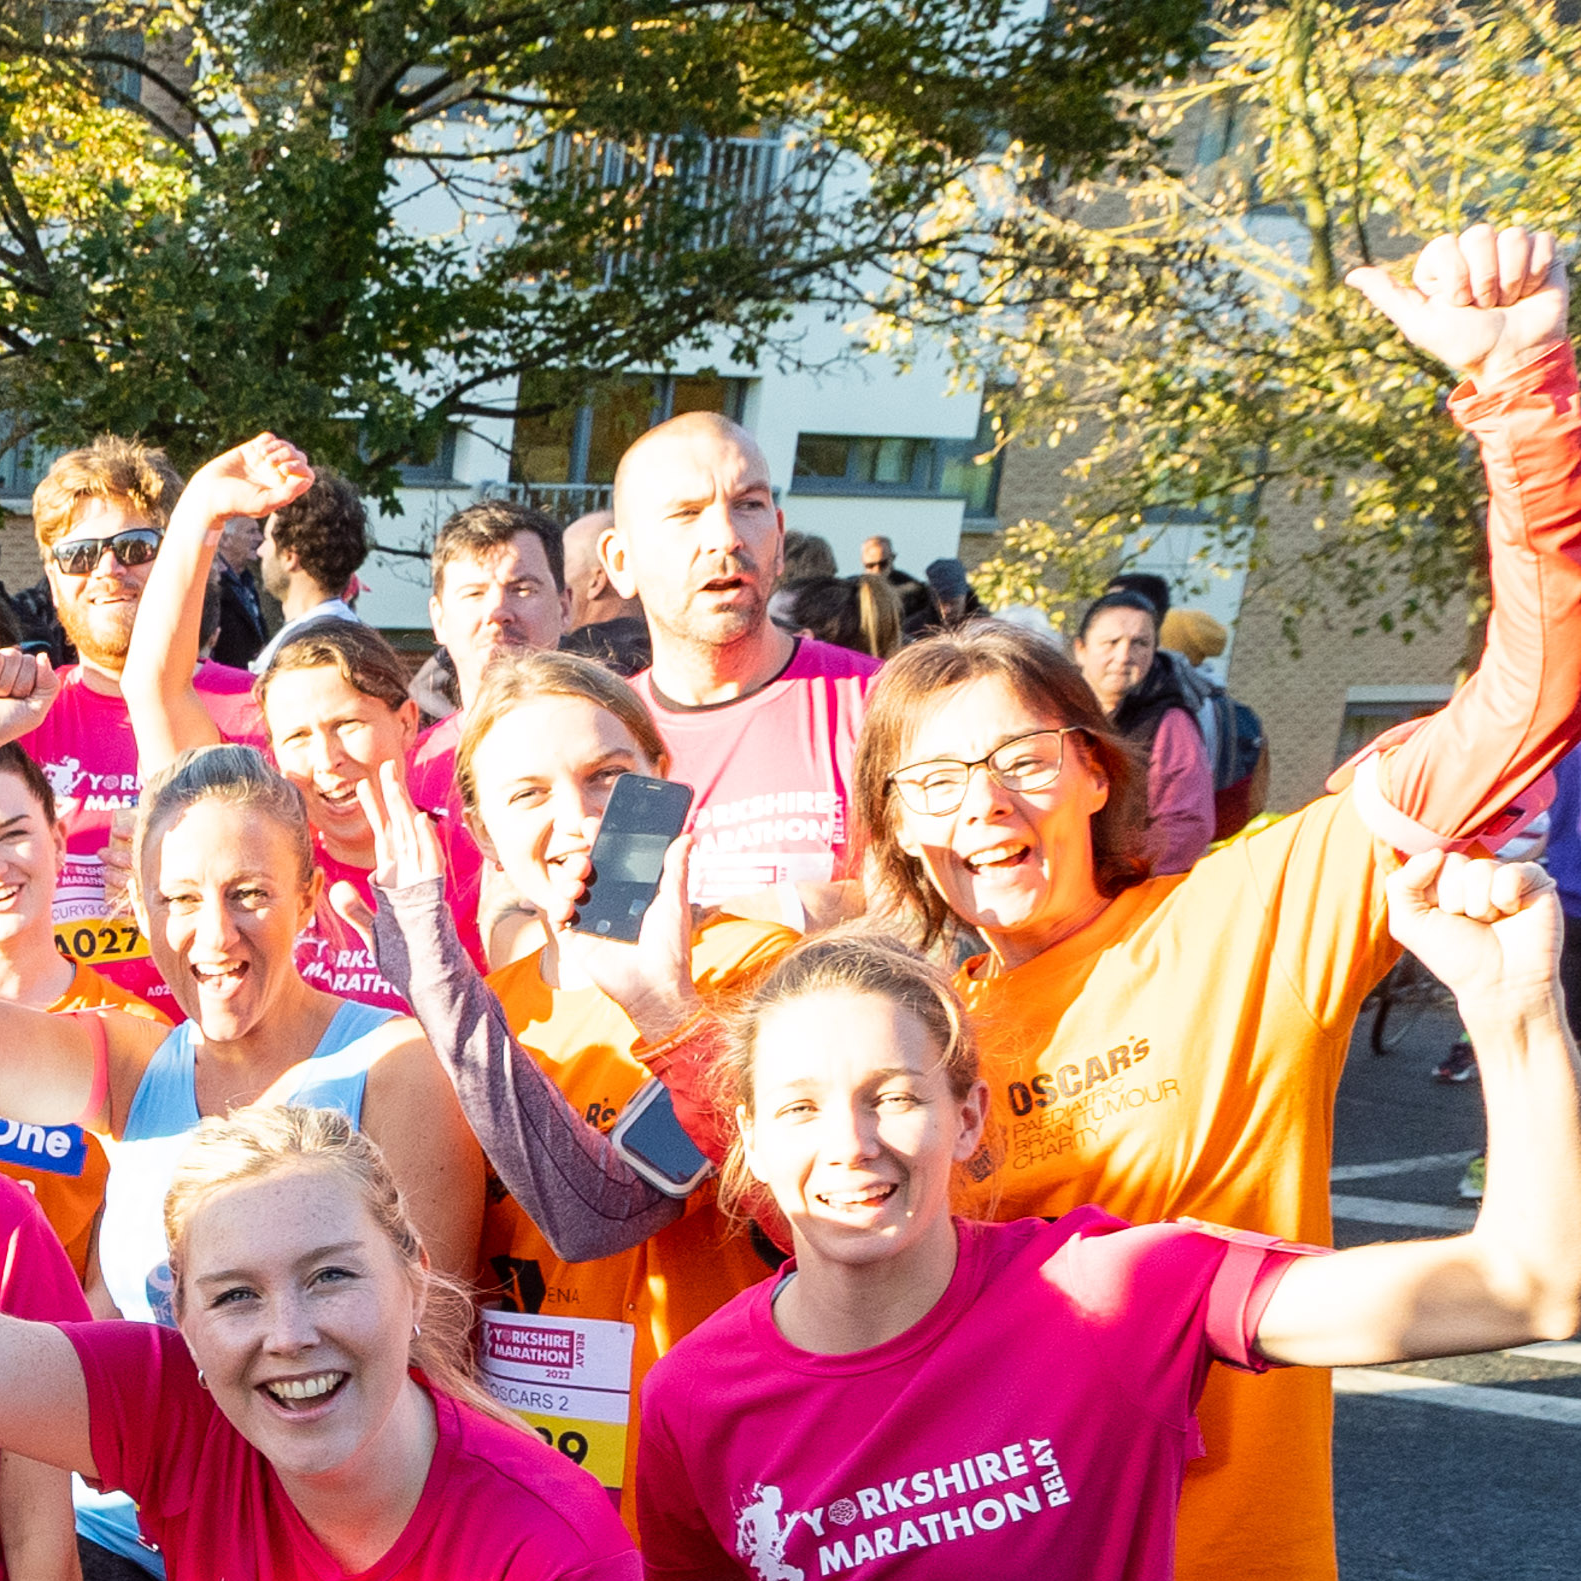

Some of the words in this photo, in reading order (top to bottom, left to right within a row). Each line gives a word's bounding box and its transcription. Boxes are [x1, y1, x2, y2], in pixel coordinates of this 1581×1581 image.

[699, 818, 829, 854] ARATHON
[146, 984, 172, 997] A02
[1014, 1118, 1077, 1155] BRAIN
[1079, 1078, 1182, 1127] TUMOUR
[1011, 1123, 1104, 1171] CHARITY
[494, 1328, 570, 1349] YORKSHIRE
[494, 1343, 570, 1364] MARATHON
[575, 1333, 586, 1368] RELAY
[545, 1369, 570, 1380] 2022
[559, 1395, 569, 1411] 2
[801, 1442, 1029, 1538] YORKSHIRE
[1027, 1437, 1071, 1509] RELAY
[818, 1486, 1042, 1577] MARATHON
